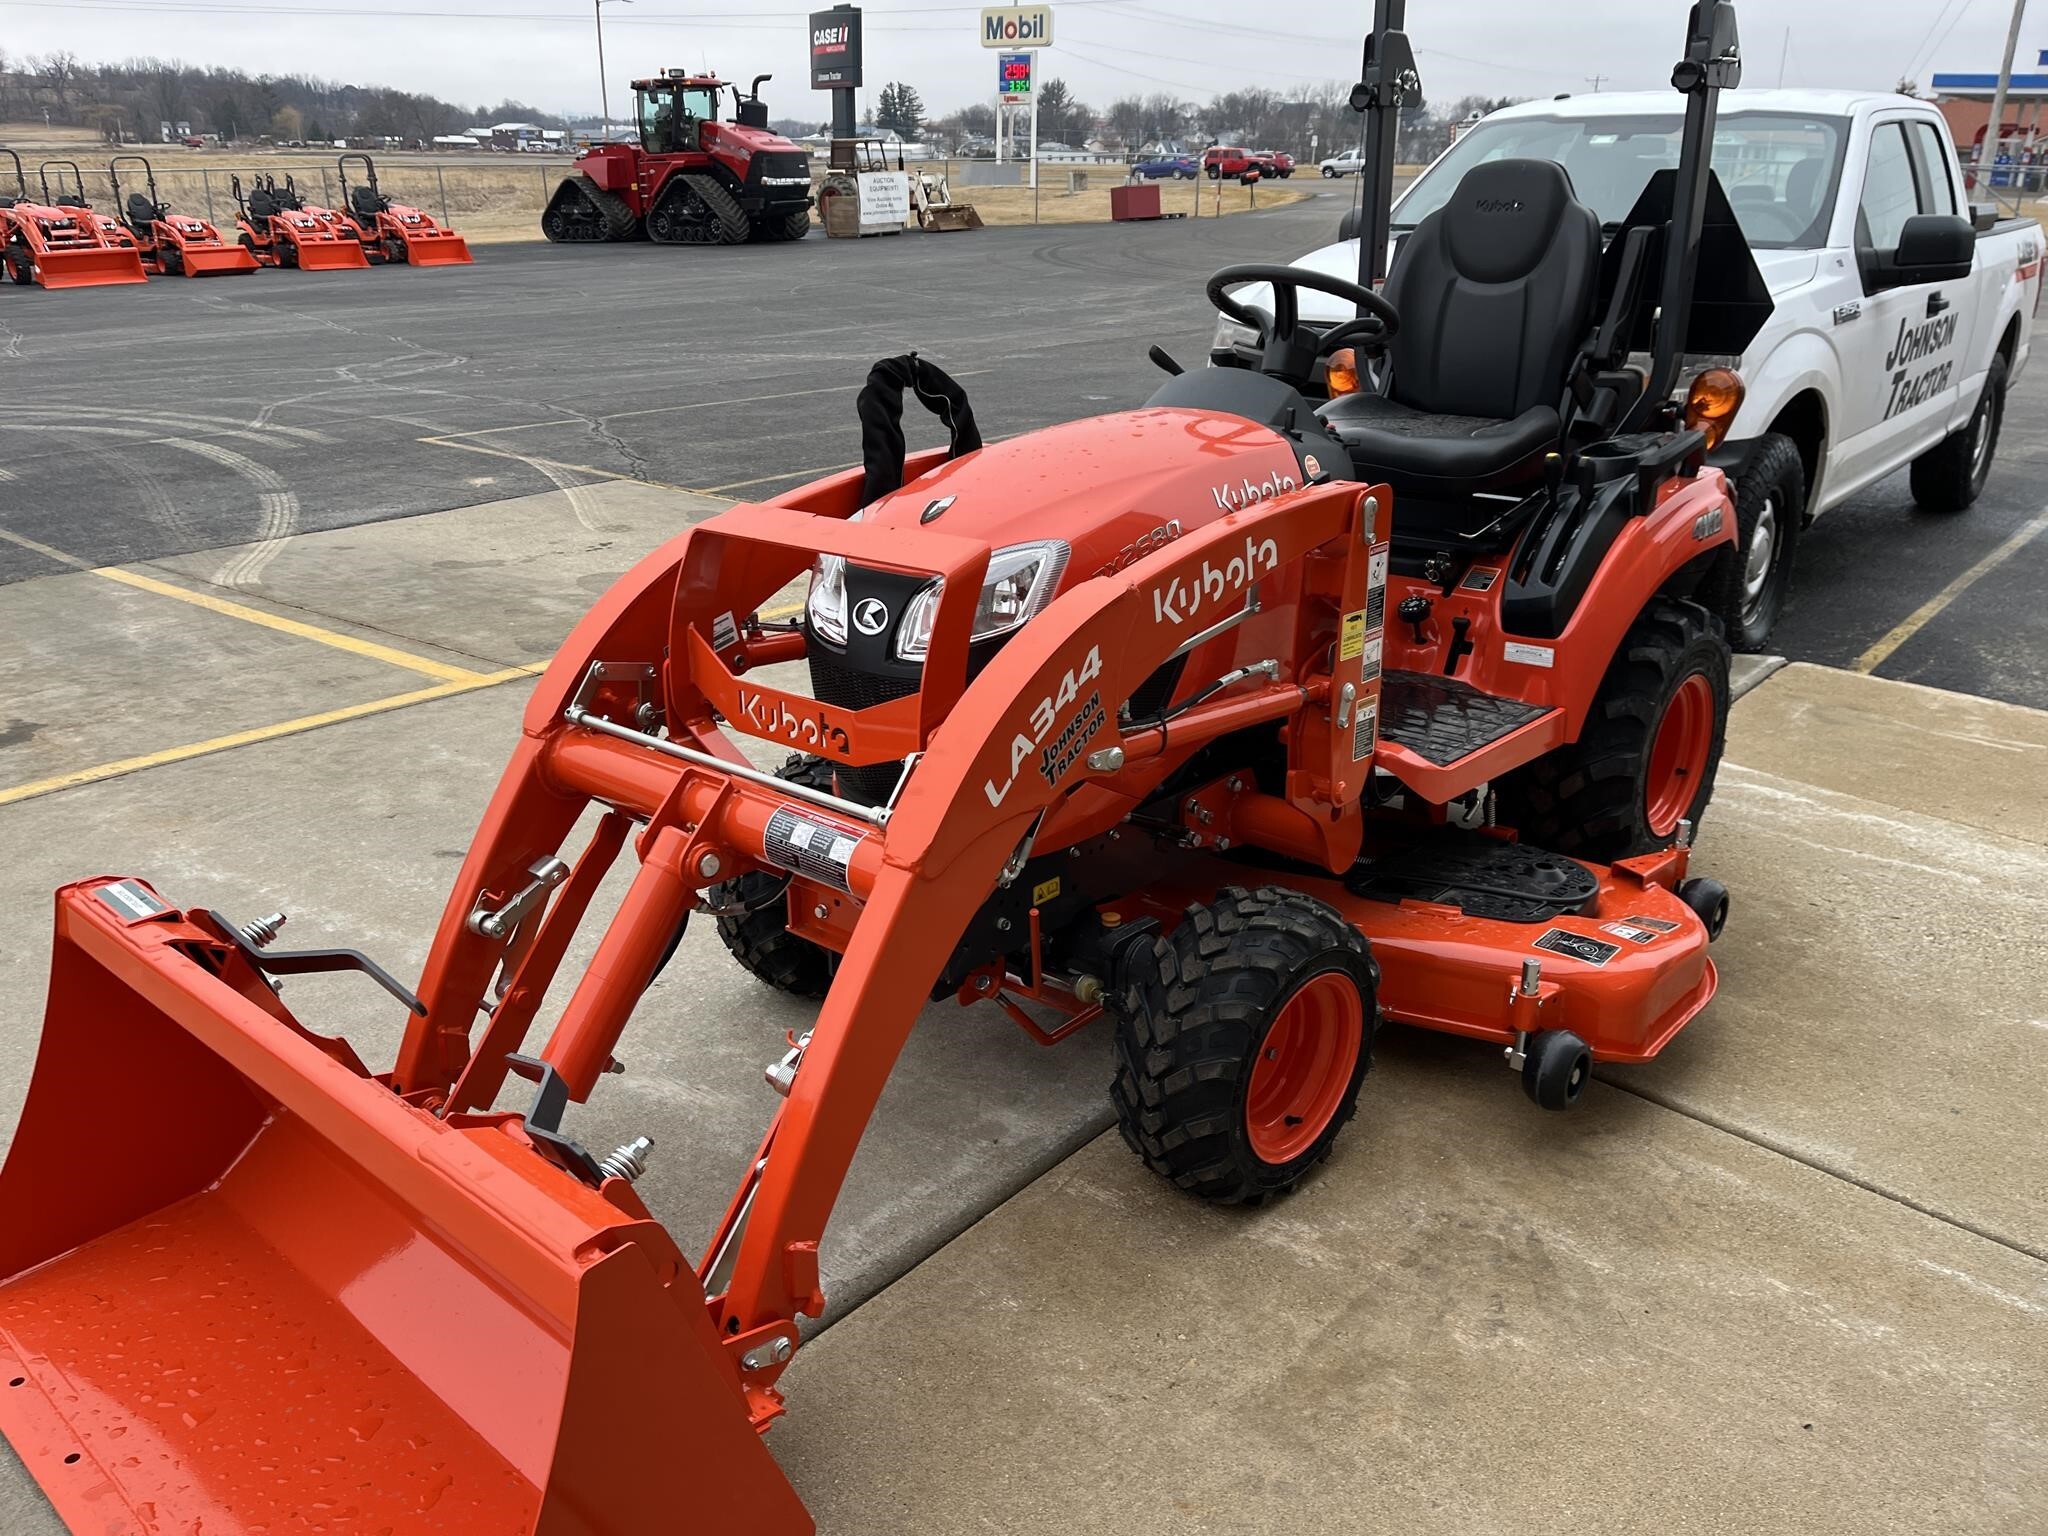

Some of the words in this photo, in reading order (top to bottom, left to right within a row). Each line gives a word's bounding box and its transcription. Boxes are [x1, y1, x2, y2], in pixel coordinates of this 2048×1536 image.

[813, 27, 838, 46] CASE
[986, 13, 1043, 40] Mobil
[872, 176, 895, 184] AUCTION
[1886, 312, 1960, 372] JOHNSON
[1882, 360, 1954, 421] TRACTOR
[1211, 470, 1296, 514] Kubota
[1153, 536, 1278, 625] Kubota
[738, 690, 850, 755] Kubota
[984, 644, 1103, 808] LA344
[1040, 690, 1100, 774] JOHNSON
[1044, 708, 1107, 788] TRACTOR
